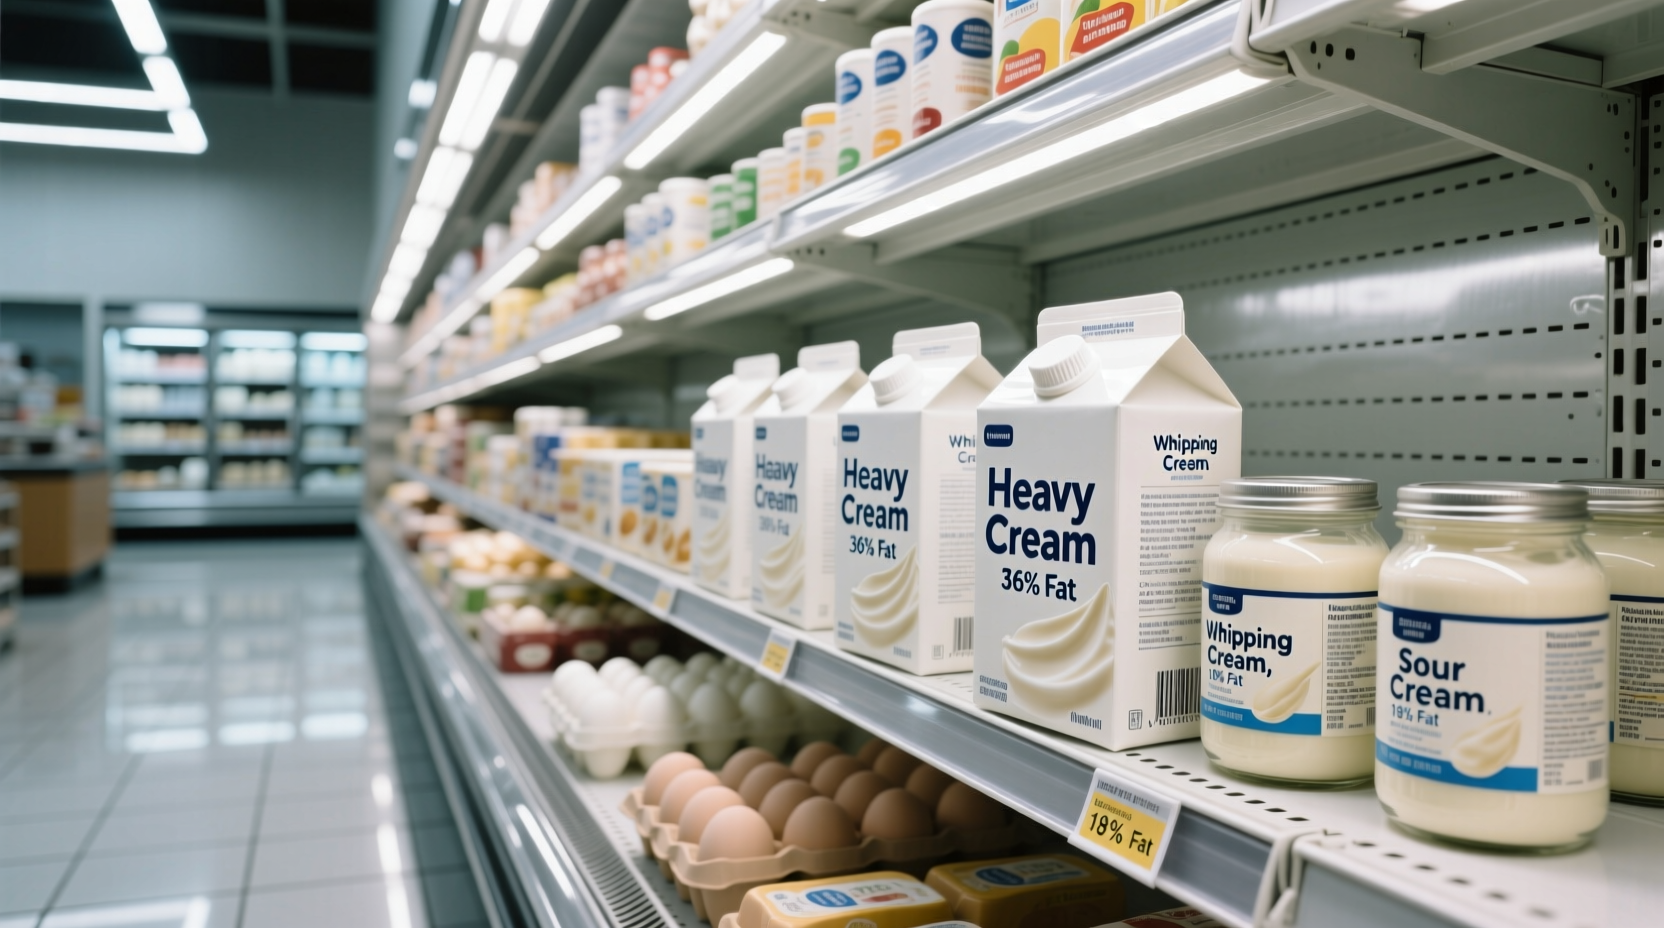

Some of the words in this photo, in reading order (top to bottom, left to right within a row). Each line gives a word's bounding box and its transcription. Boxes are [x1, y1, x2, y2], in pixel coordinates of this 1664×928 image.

[1153, 433, 1218, 455] Whipping
[843, 457, 909, 502] Heavy
[987, 466, 1096, 526] Heavy
[755, 483, 799, 514] Cream
[841, 494, 909, 532] Cream
[849, 535, 875, 556] 36%
[878, 539, 897, 560] Fat
[985, 513, 1097, 566] Cream
[1001, 567, 1040, 595] 36%
[1045, 573, 1077, 602] Fat
[1206, 618, 1293, 657] Whipping
[1207, 644, 1273, 679] Cream,
[1398, 647, 1466, 682] Sour
[1417, 710, 1439, 727] Fat
[1089, 811, 1125, 845] 18%
[1128, 829, 1155, 857] Fat
